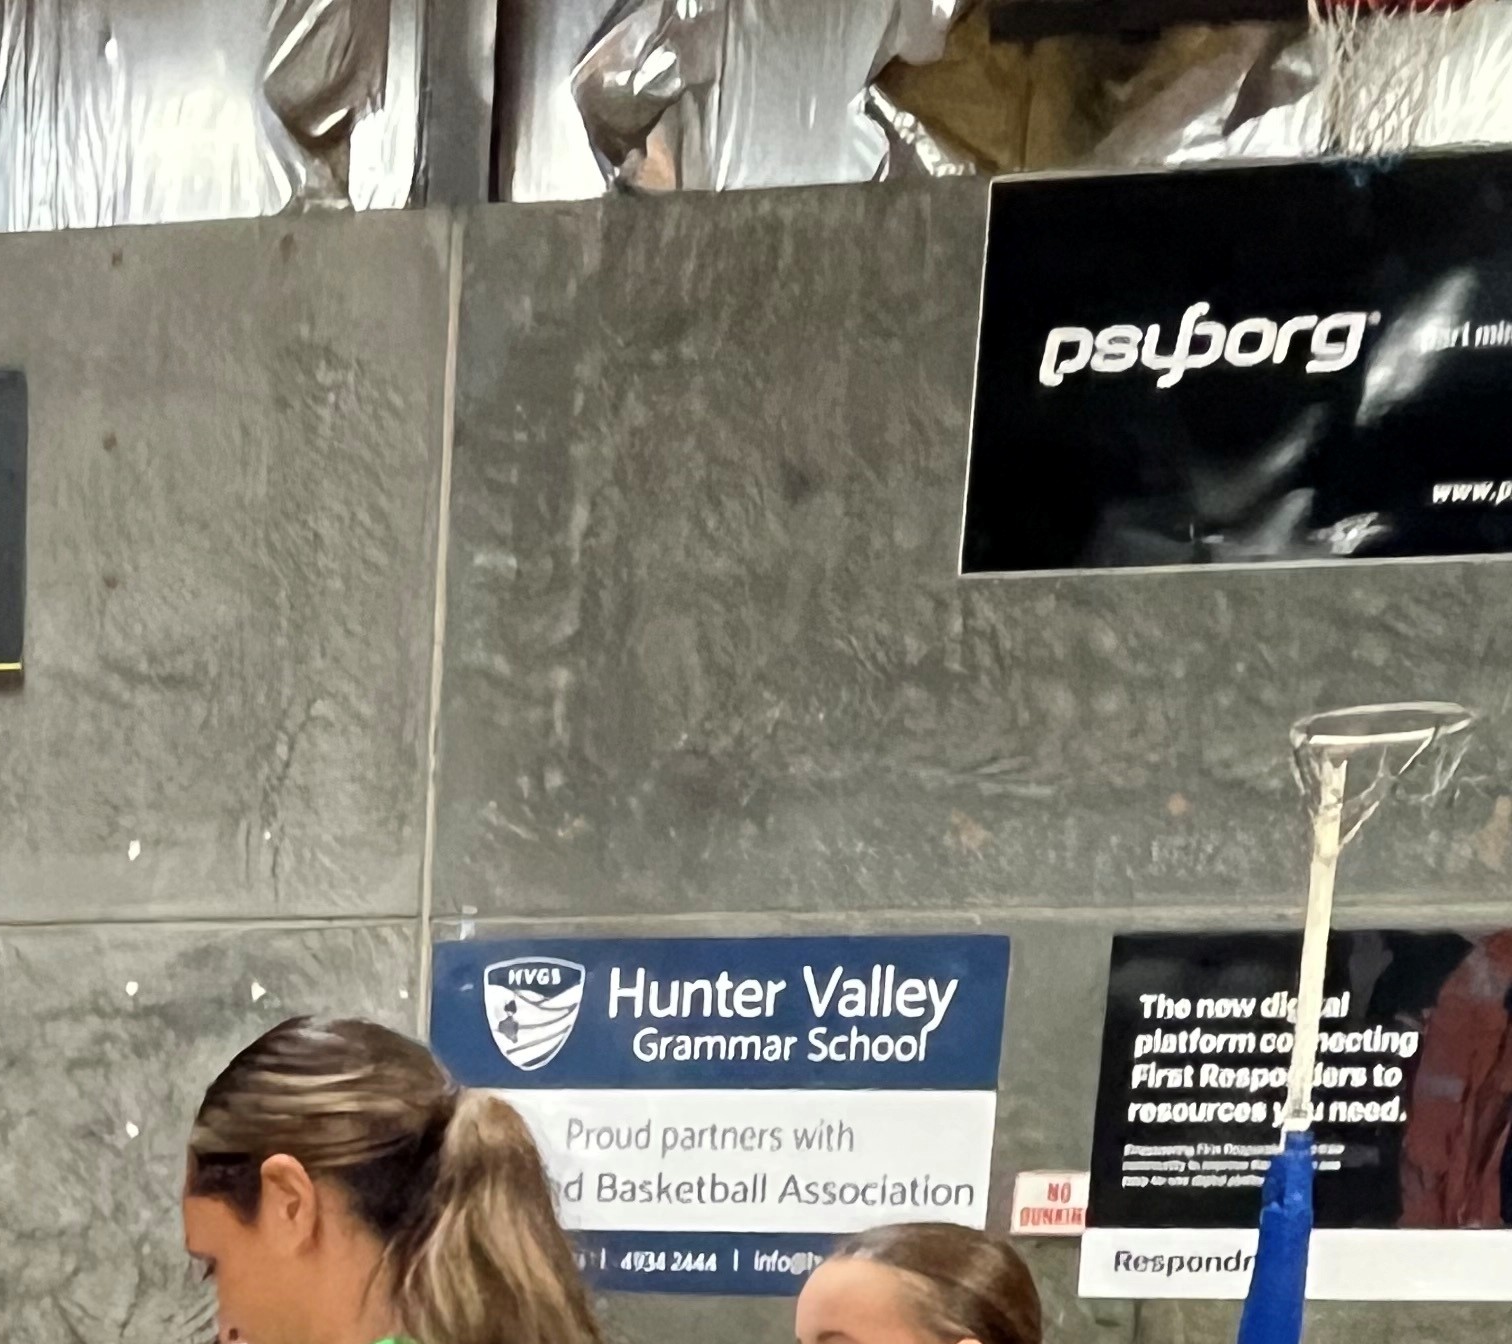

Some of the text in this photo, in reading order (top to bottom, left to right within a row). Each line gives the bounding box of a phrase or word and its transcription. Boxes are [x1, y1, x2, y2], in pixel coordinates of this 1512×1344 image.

[1039, 301, 1368, 389] psyborg
[608, 963, 959, 1033] Hunter Valley
[1139, 993, 1192, 1019] The
[1196, 998, 1256, 1019] new
[632, 1025, 928, 1062] Grammar School
[1134, 1026, 1257, 1058] platform
[1131, 1061, 1194, 1089] First
[1372, 1062, 1403, 1088] to
[1128, 1101, 1268, 1124] resources
[1328, 1096, 1408, 1123] need.
[565, 1118, 855, 1158] Proud partners with
[596, 1172, 768, 1204] Basketball
[777, 1173, 976, 1207] Association
[1047, 1182, 1072, 1204] NO
